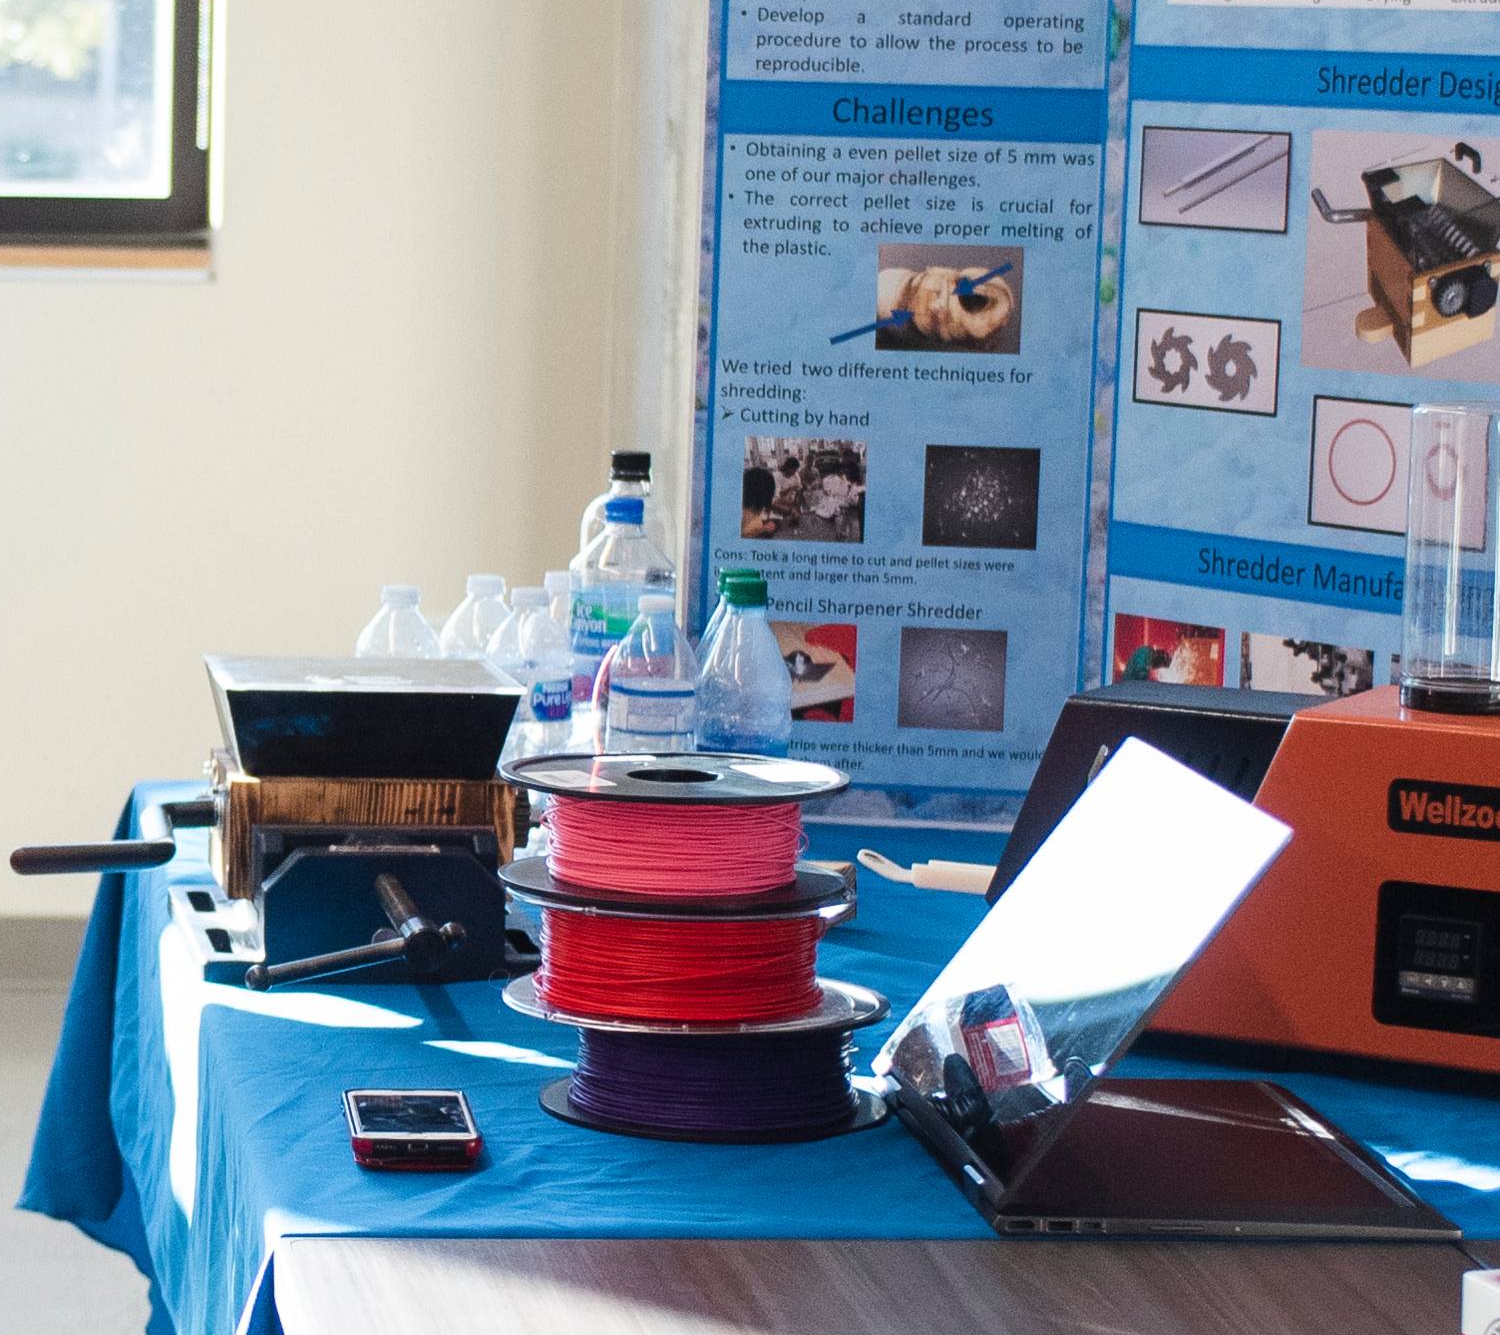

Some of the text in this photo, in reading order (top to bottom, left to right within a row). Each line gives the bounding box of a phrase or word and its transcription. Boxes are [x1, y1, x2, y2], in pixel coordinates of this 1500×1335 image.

[757, 7, 1084, 33] Develop a standard operating
[756, 32, 1083, 54] procedure to allow the process to be
[756, 57, 864, 74] reproducible.
[1318, 65, 1432, 97] Shredder
[833, 97, 993, 132] Challenges
[746, 142, 1095, 166] Obtaining a even pellet size of 5 mm was
[745, 167, 980, 190] one of our major challenges.
[744, 190, 1093, 215] The correct pellet size is crucial for
[743, 216, 1093, 241] extruding to achieve proper melting of
[743, 238, 831, 257] the plastic.
[722, 359, 1033, 385] We tried two different techniques for
[721, 383, 806, 403] shredding:
[740, 407, 869, 427] Cutting by hand
[714, 548, 1015, 571] Cons: Took a long time to cut and pellet sizes were
[1198, 547, 1306, 588] Shredder
[789, 570, 811, 581] and
[815, 570, 848, 584] larger
[852, 572, 879, 583] than
[884, 573, 917, 584] 5mm.
[766, 594, 982, 620] Pencil Sharpener Shredder
[787, 738, 817, 751] trips
